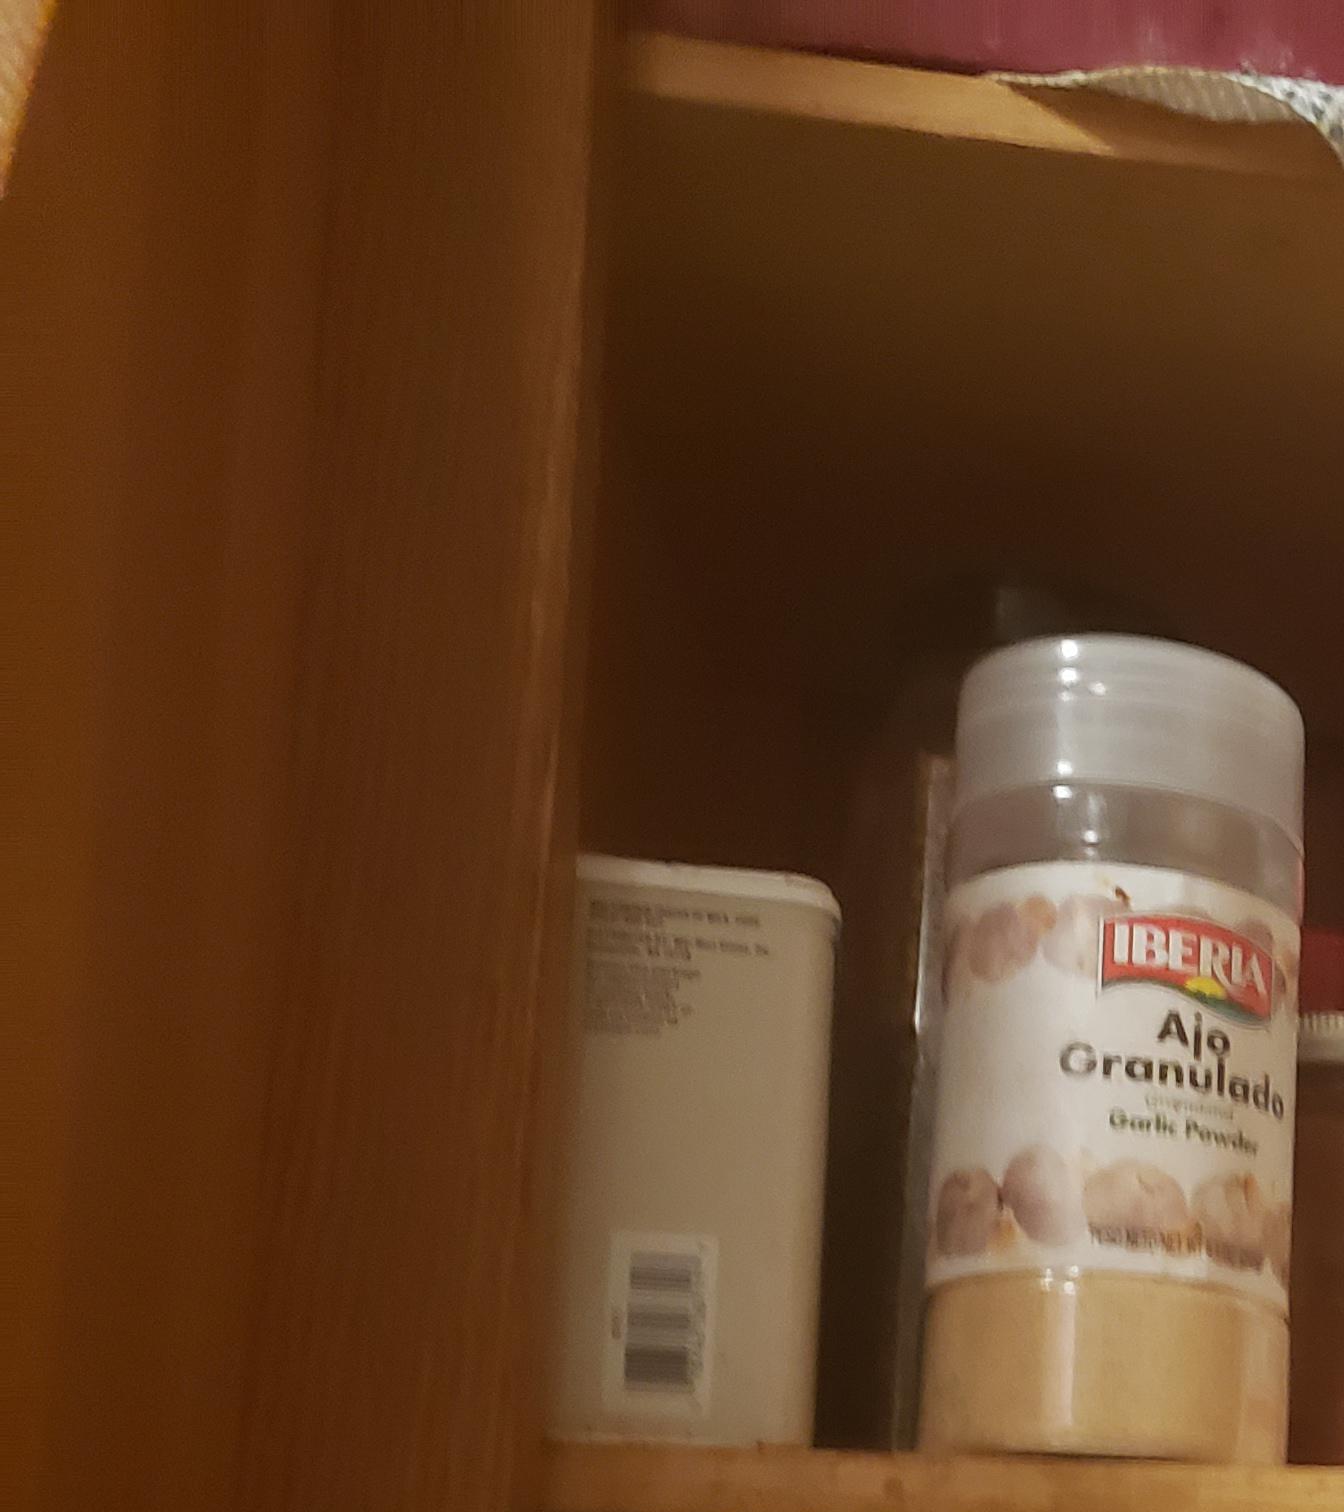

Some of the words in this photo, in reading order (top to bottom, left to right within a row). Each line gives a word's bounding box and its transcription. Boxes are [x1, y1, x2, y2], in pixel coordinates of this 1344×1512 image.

[1113, 921, 1269, 996] IBERIA
[1157, 1009, 1231, 1060] Ajo
[1059, 1042, 1285, 1120] Granulado
[1109, 1106, 1177, 1138] Garlic
[1185, 1118, 1258, 1156] Powder
